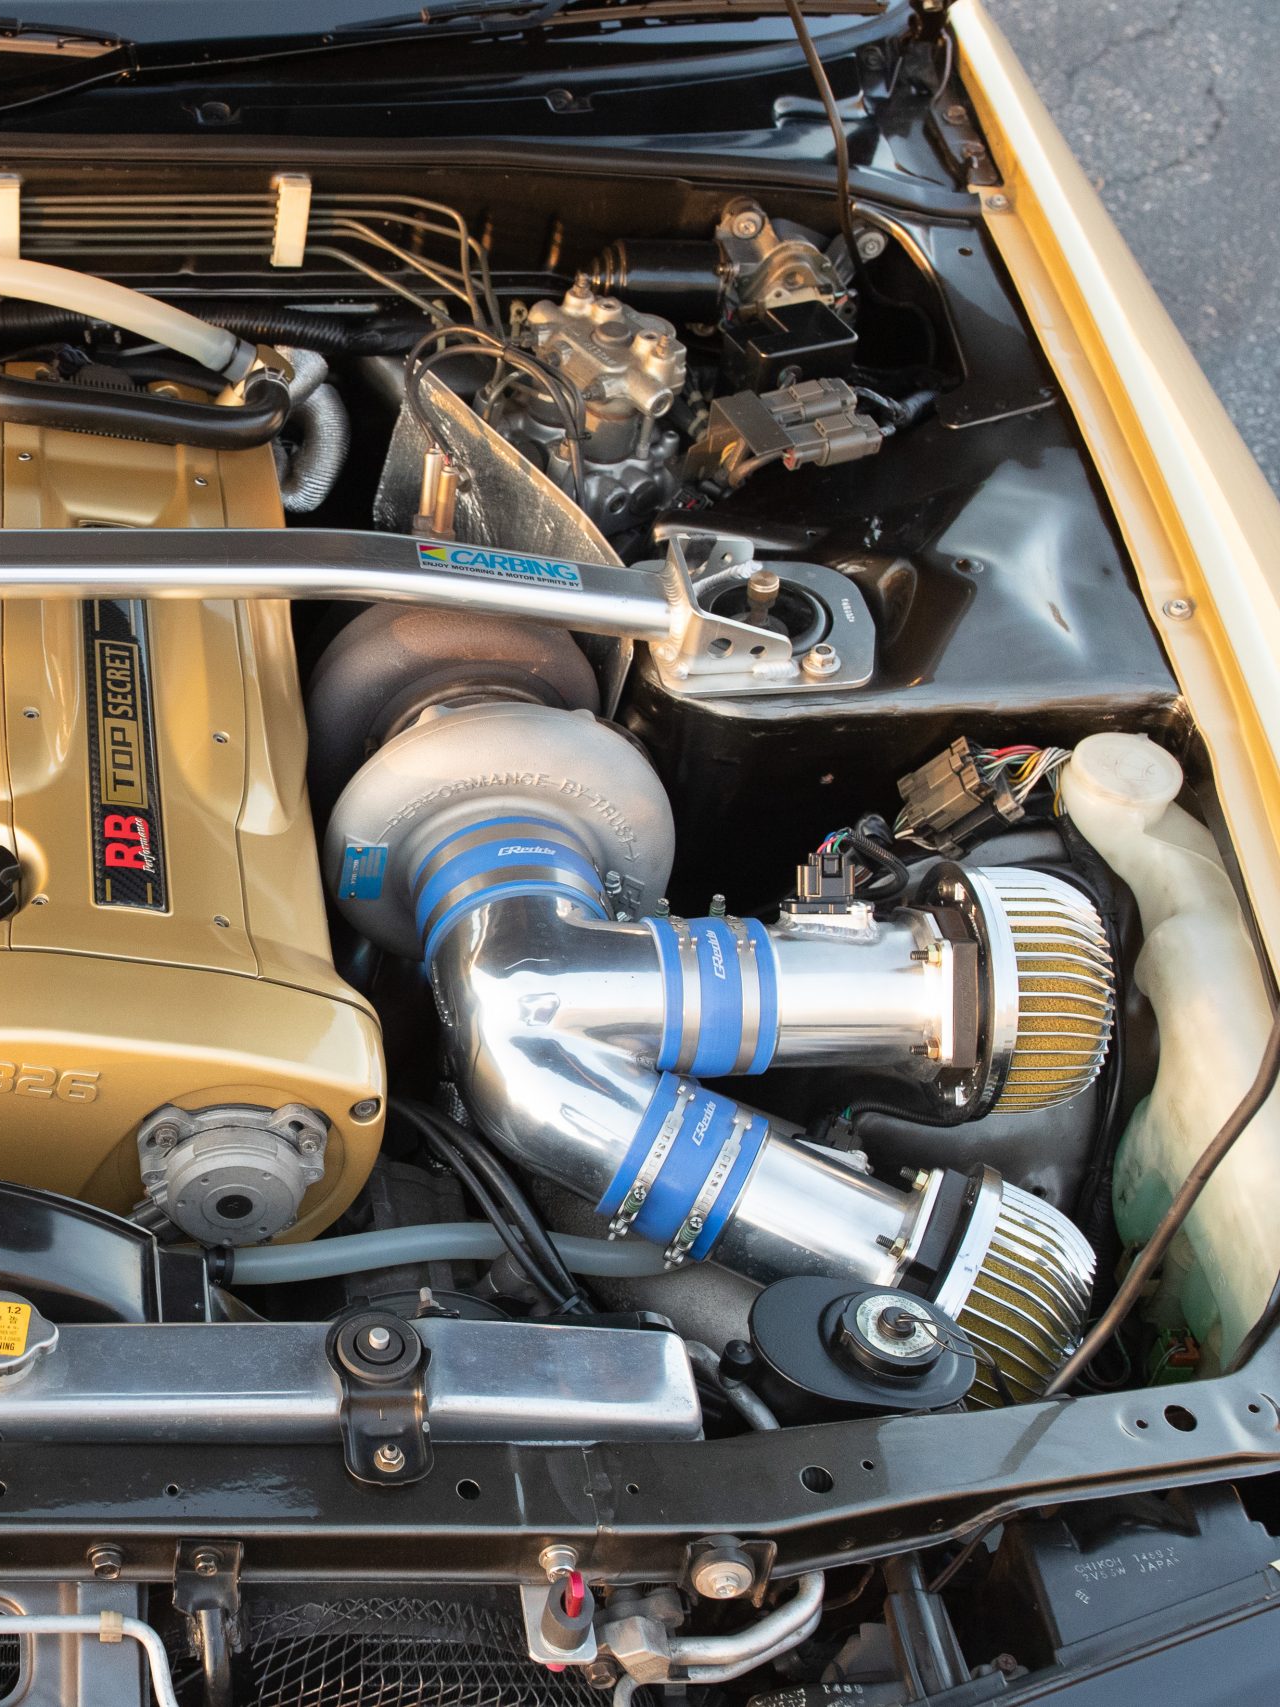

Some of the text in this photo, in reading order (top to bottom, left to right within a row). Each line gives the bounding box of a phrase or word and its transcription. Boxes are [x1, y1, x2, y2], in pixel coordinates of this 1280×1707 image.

[423, 561, 449, 569] ENJOY
[451, 565, 495, 576] MOTORING
[506, 572, 535, 581] MOTOR
[537, 577, 567, 586] SPIRITS
[450, 550, 578, 581] CARBING
[107, 646, 136, 792] TOP SECRET
[387, 771, 639, 846] PERFORMANCE BY TRUST
[104, 813, 150, 871] RB
[134, 817, 156, 874] Performance
[497, 845, 557, 857] GReddy
[705, 929, 726, 980] GReddy
[691, 1099, 716, 1146] GReddy
[7, 1306, 21, 1314] 1.2
